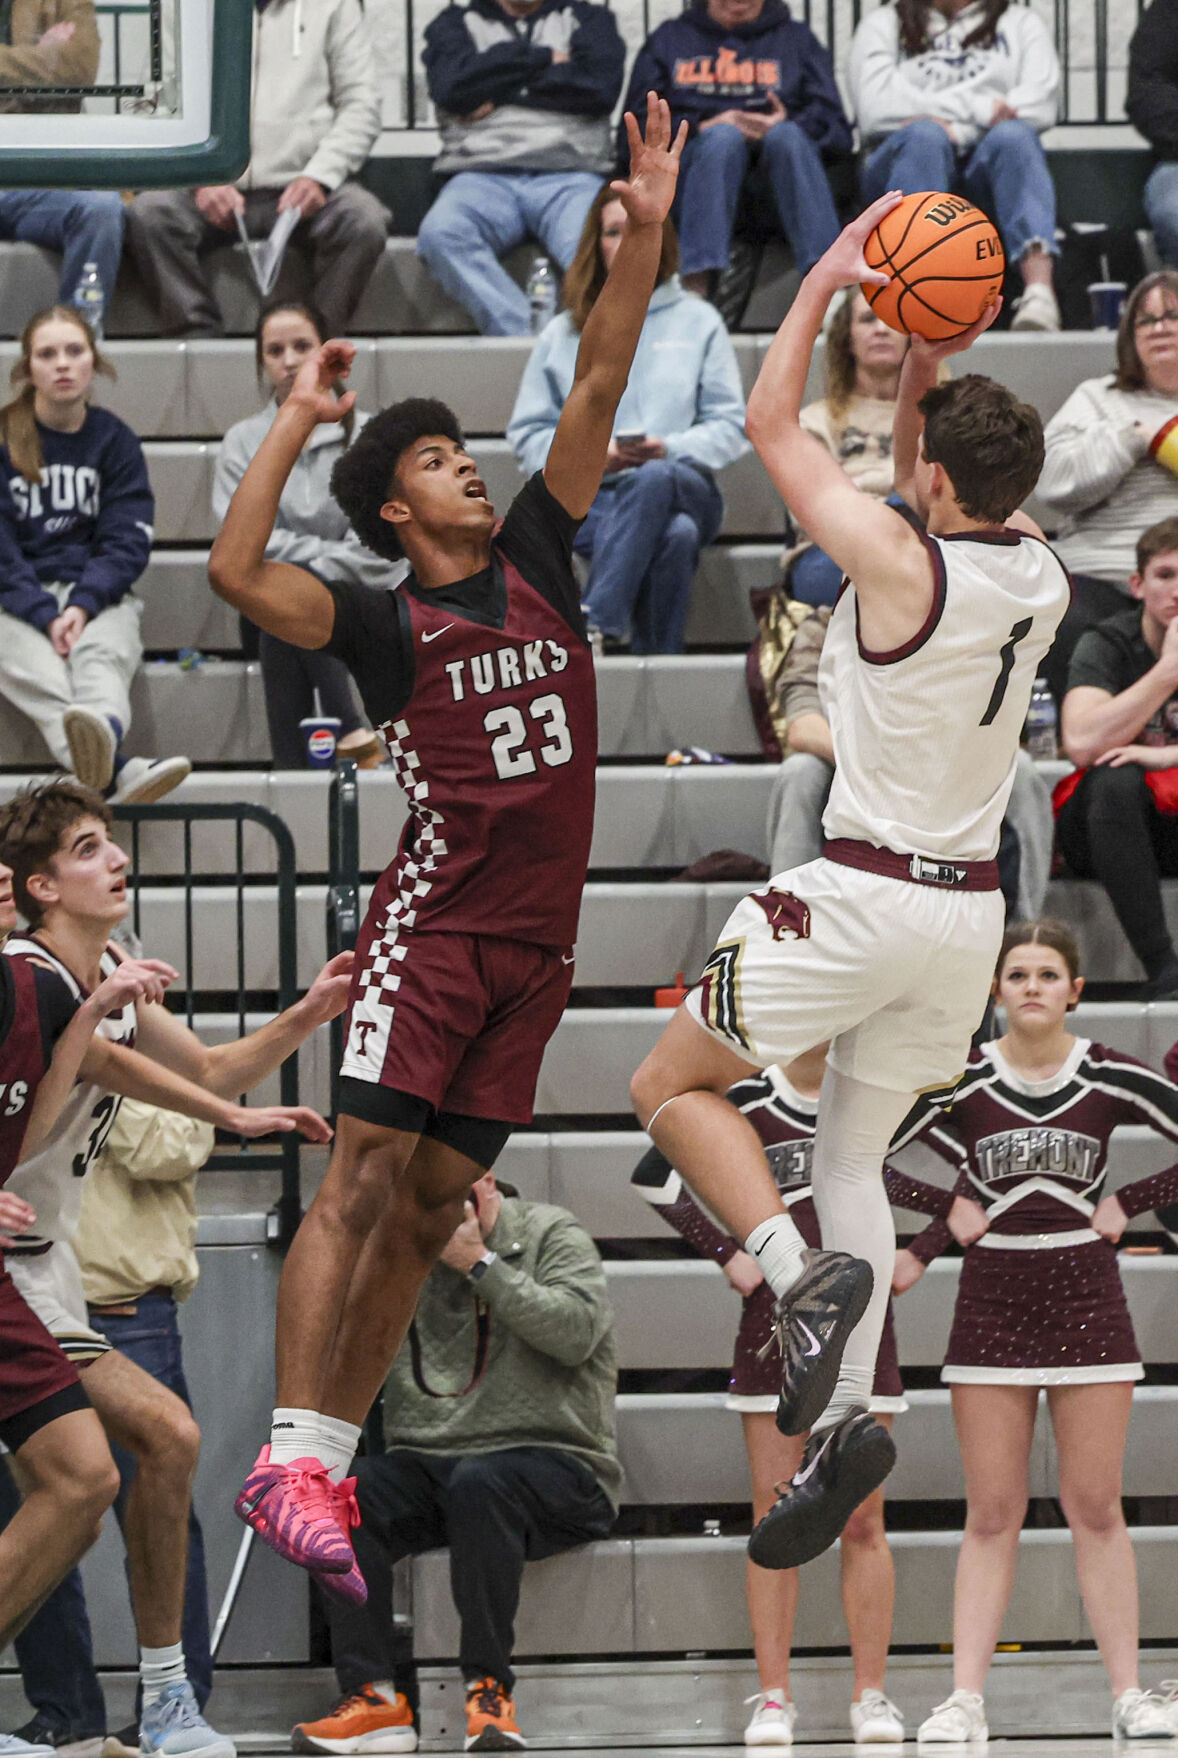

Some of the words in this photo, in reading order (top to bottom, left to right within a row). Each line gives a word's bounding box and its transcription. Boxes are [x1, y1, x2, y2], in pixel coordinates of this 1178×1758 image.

[445, 639, 569, 701] TURKS
[979, 616, 1034, 726] 1
[483, 693, 574, 780] 23
[355, 1020, 377, 1056] T
[976, 1127, 1100, 1183] TREMONT
